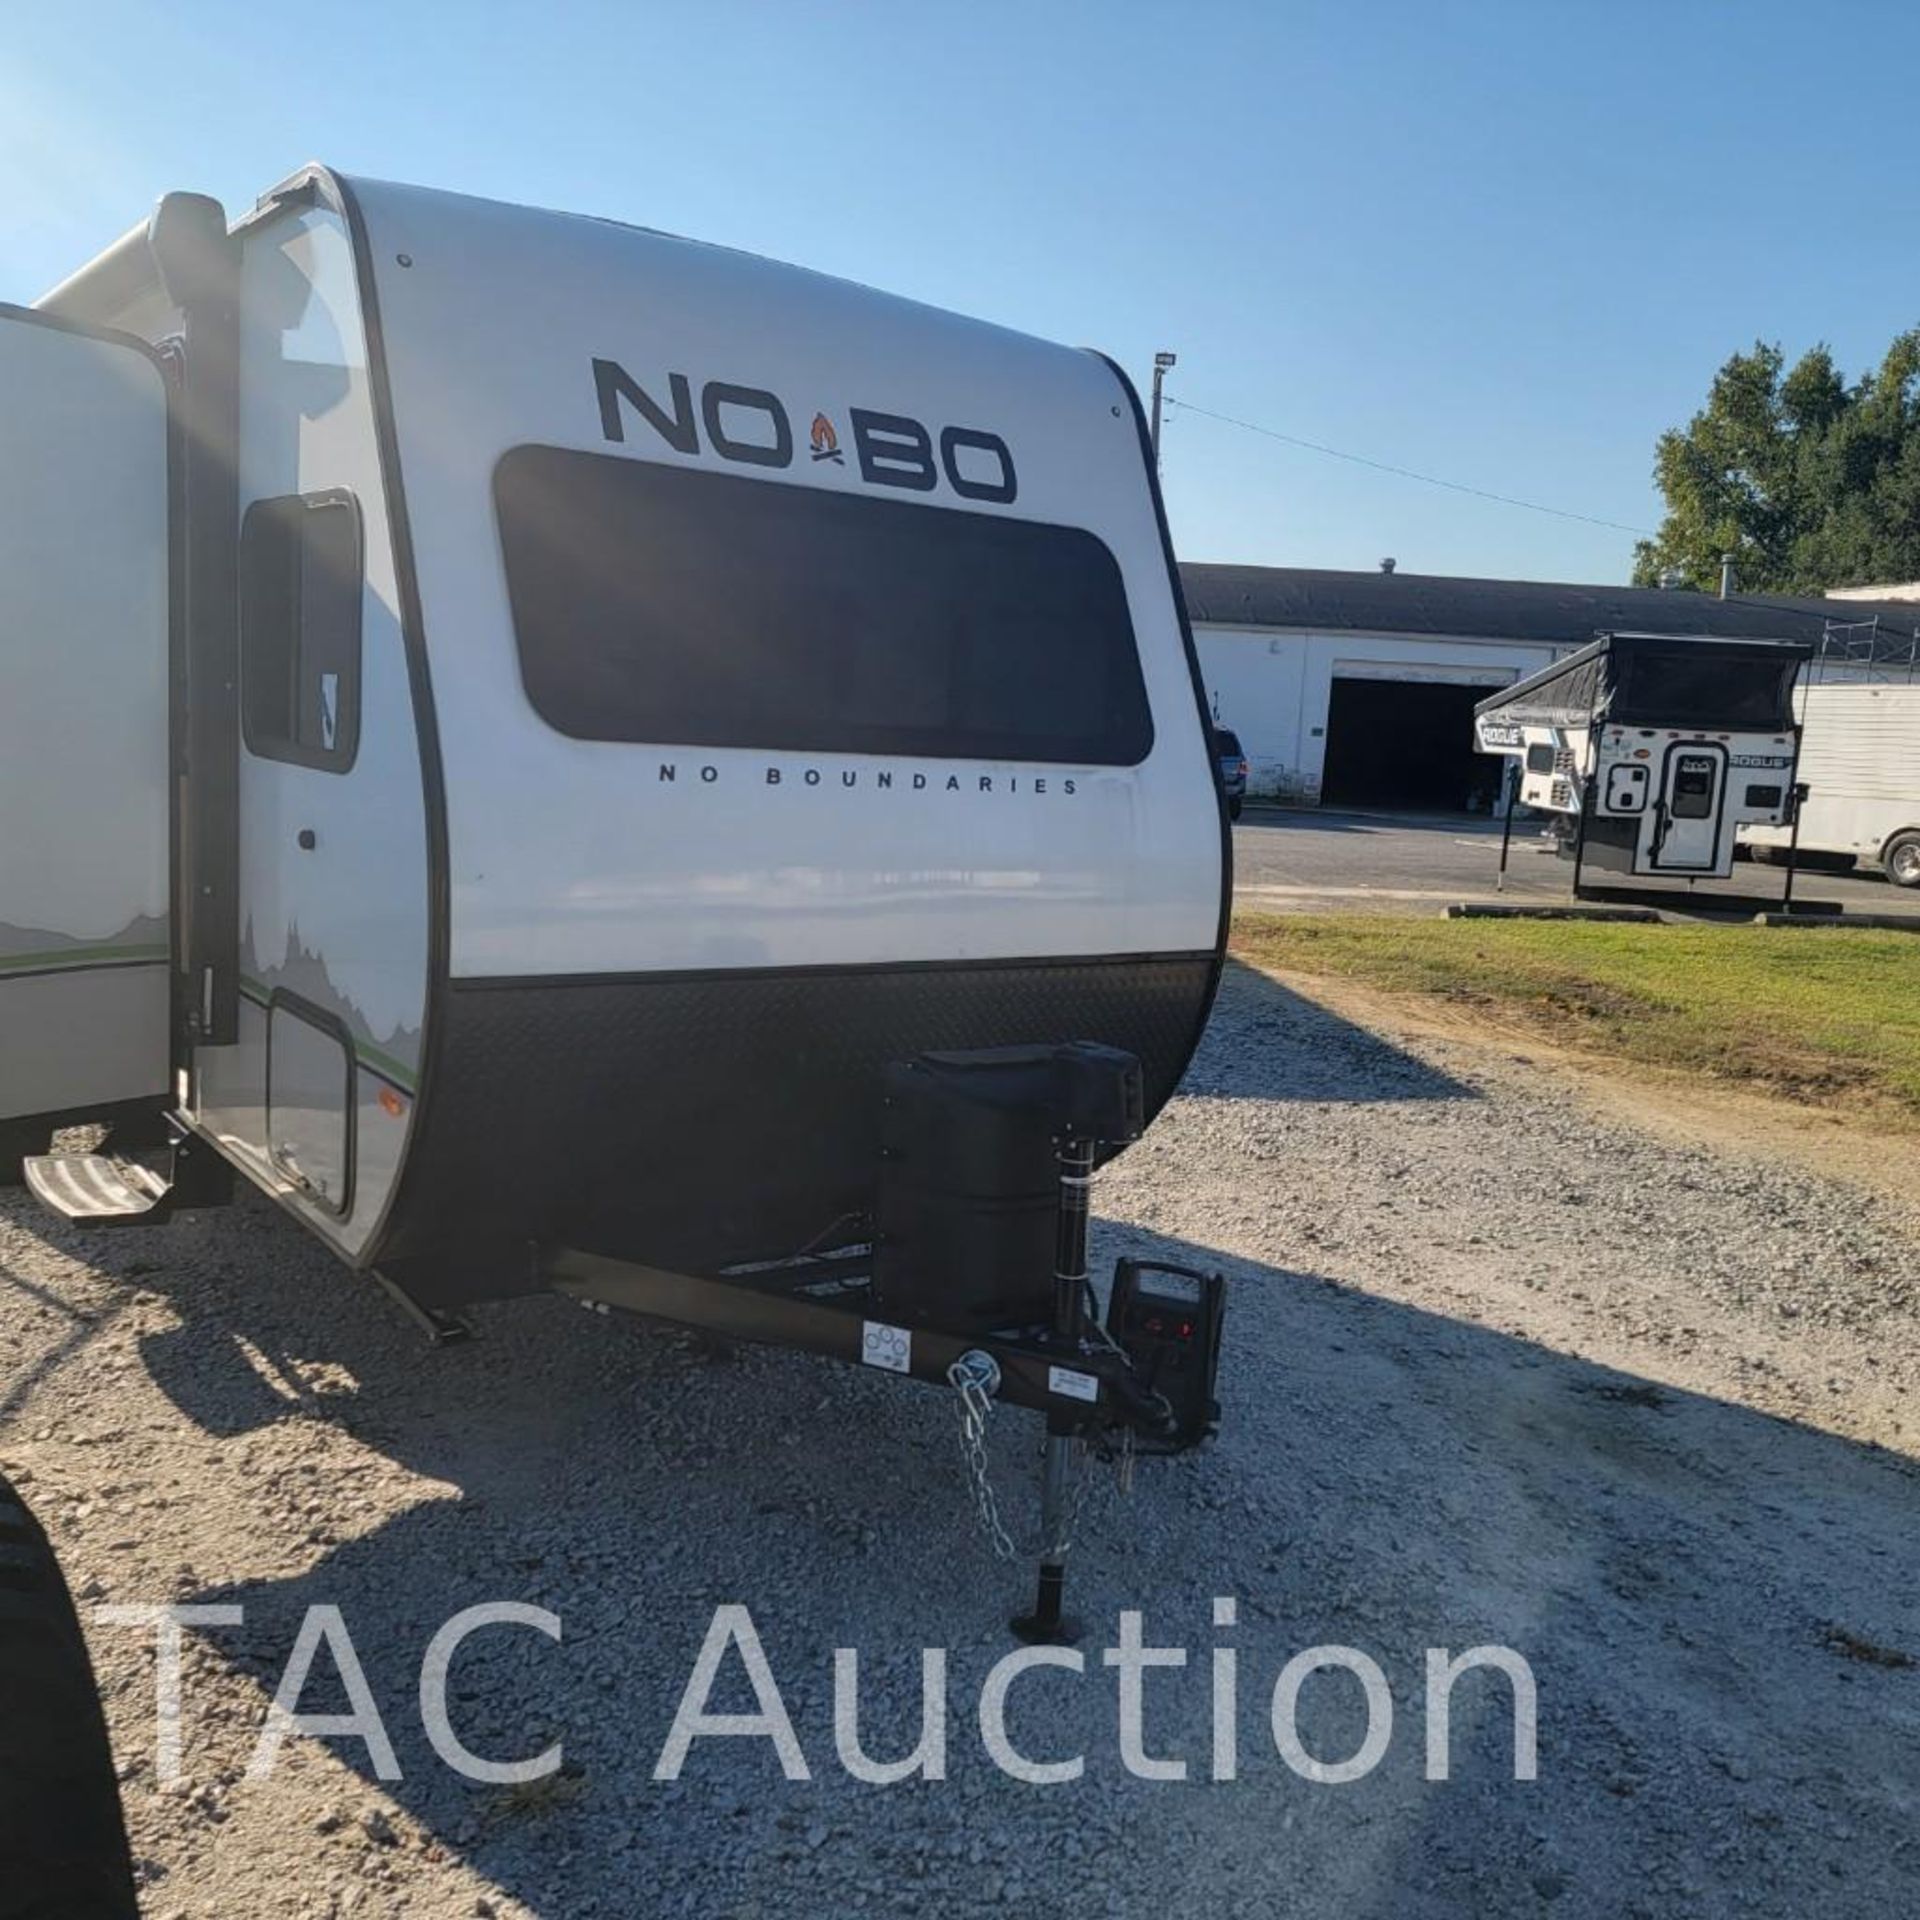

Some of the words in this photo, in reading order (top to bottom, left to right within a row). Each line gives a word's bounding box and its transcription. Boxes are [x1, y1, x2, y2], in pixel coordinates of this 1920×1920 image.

[592, 358, 793, 468] NO
[849, 407, 1017, 504] BO
[1483, 727, 1518, 745] ROGUE
[659, 764, 718, 784] NO
[766, 767, 1076, 795] BOUNDARIES
